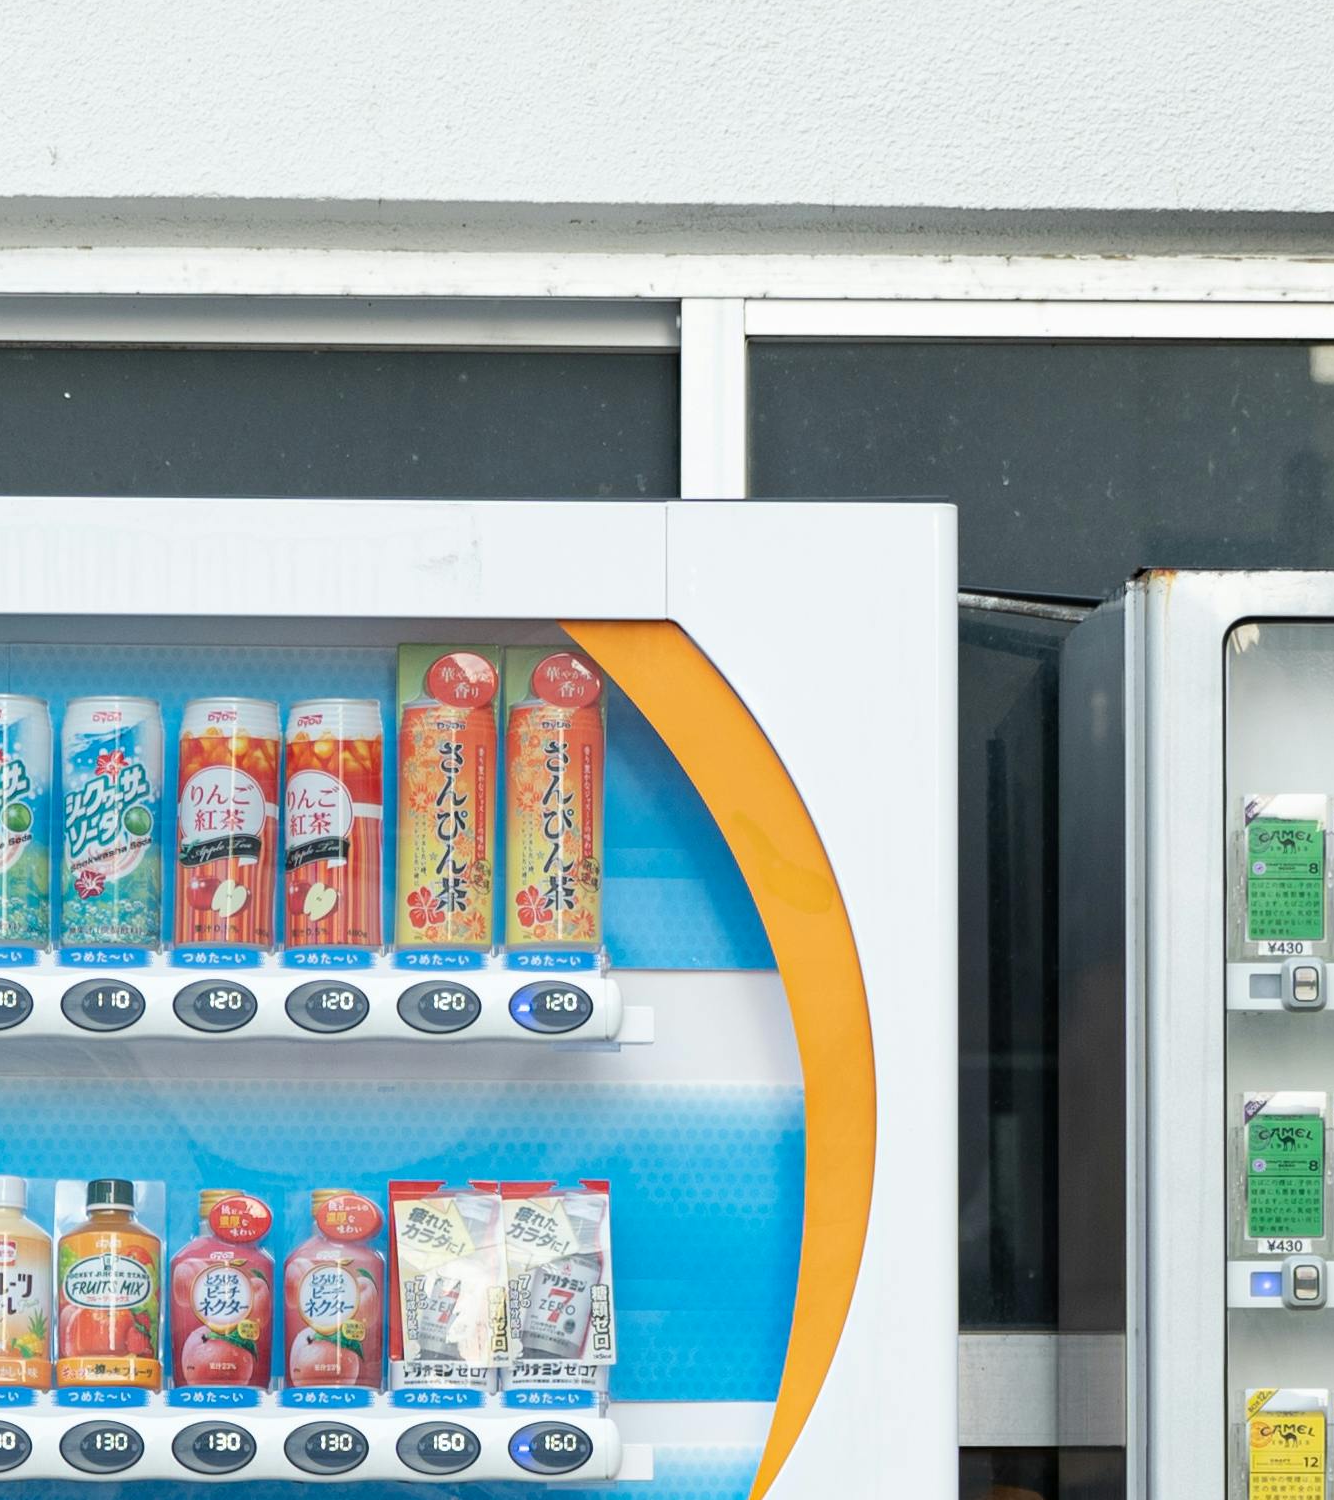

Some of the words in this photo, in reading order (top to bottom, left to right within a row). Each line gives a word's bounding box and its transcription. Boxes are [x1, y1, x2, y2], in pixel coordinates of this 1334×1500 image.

[189, 782, 255, 808] りんご
[194, 809, 245, 832] 紅茶
[436, 742, 468, 912] さんぴん茶
[542, 742, 575, 912] さんぴん茶
[1258, 831, 1313, 844] CAMEL
[1267, 942, 1303, 954] ¥430
[545, 992, 577, 1012] 120
[71, 1282, 115, 1295] FRUITS
[120, 1282, 144, 1295] MIX
[207, 1286, 240, 1299] ピーチ
[200, 1298, 249, 1316] ネクター
[539, 1299, 576, 1316] ZERO
[209, 1432, 241, 1452] 130
[433, 1432, 465, 1452] 160
[1304, 1457, 1319, 1468] 12
